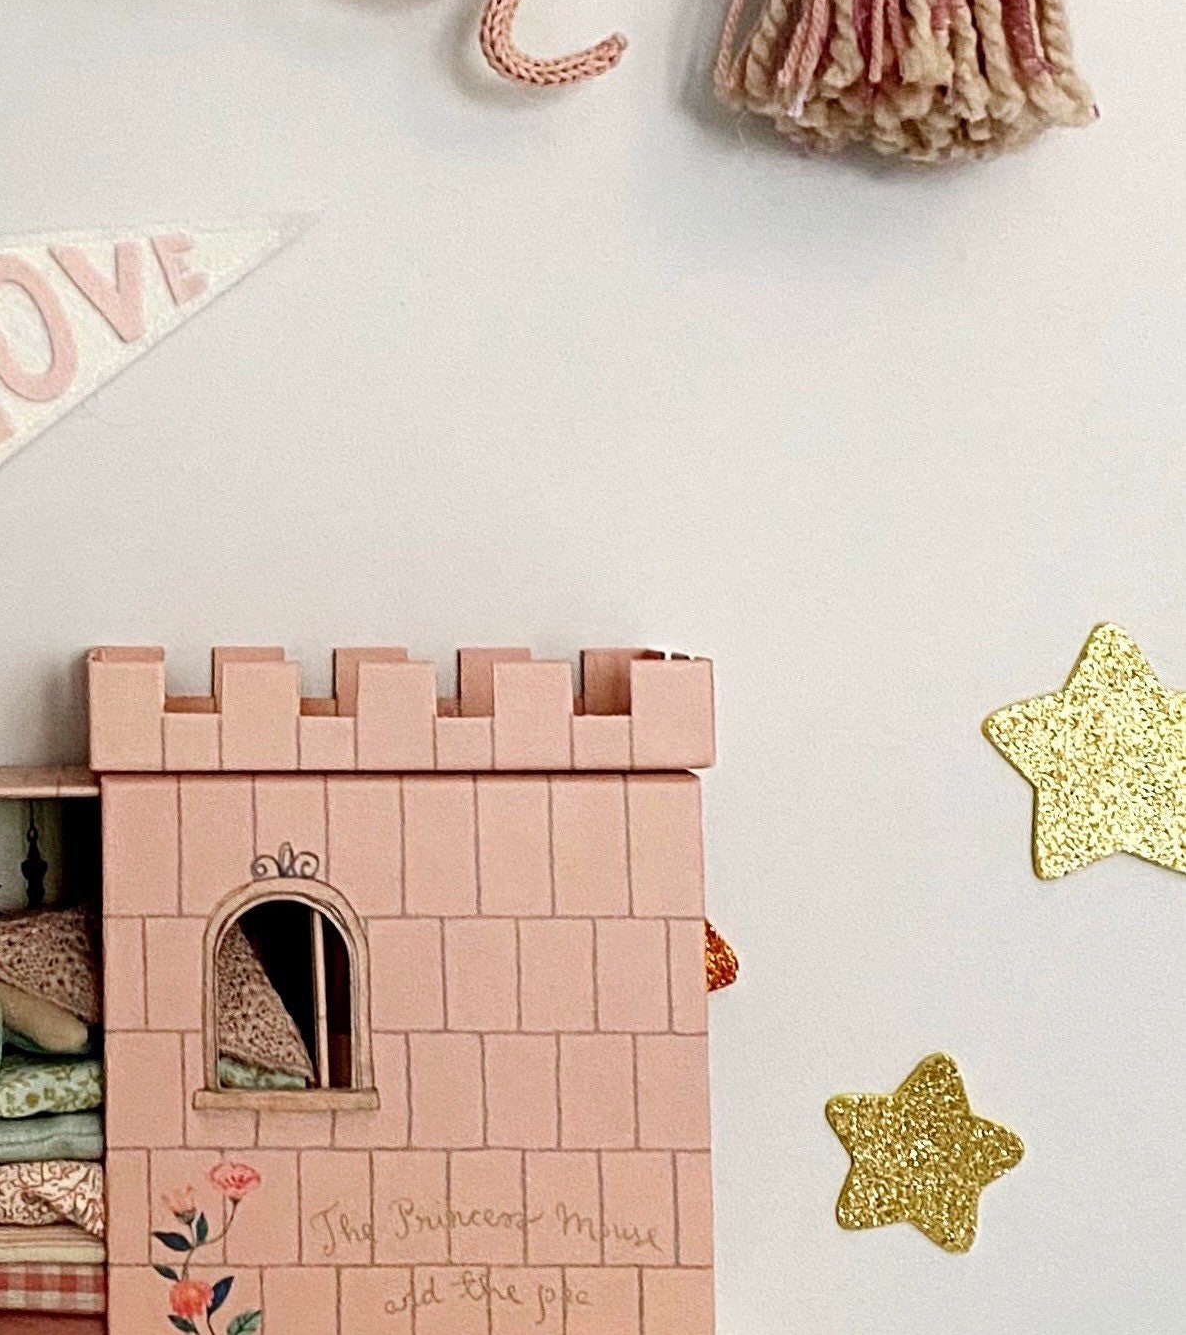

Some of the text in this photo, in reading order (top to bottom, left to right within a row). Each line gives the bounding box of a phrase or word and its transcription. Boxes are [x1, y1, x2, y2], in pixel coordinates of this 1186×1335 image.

[310, 1197, 664, 1256] The Princess Mouse
[384, 1276, 442, 1315] and
[449, 1270, 523, 1305] the
